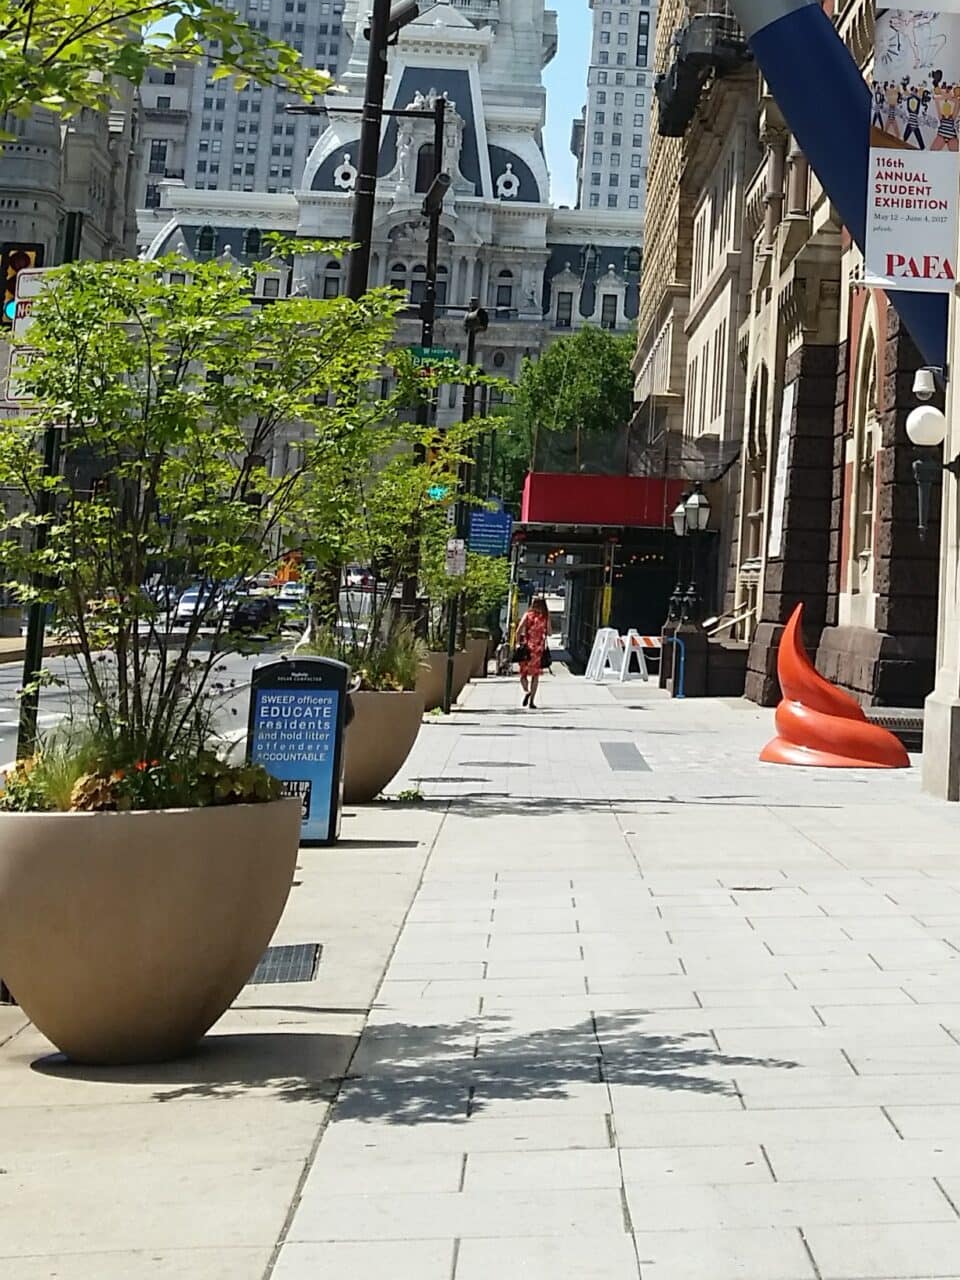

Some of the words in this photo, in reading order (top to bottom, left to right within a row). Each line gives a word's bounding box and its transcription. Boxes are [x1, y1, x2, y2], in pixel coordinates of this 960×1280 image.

[876, 157, 904, 168] 116th
[875, 170, 928, 182] ANNUAL
[875, 183, 932, 196] STUDENT
[875, 197, 948, 210] EXHIBITION
[886, 253, 955, 280] PAFA
[261, 695, 295, 704] SWEEP
[297, 695, 332, 704] officers
[260, 706, 332, 718] EDUCATE
[260, 720, 330, 729] residents
[258, 731, 277, 740] and
[280, 731, 302, 740] hold
[305, 731, 330, 740] litter
